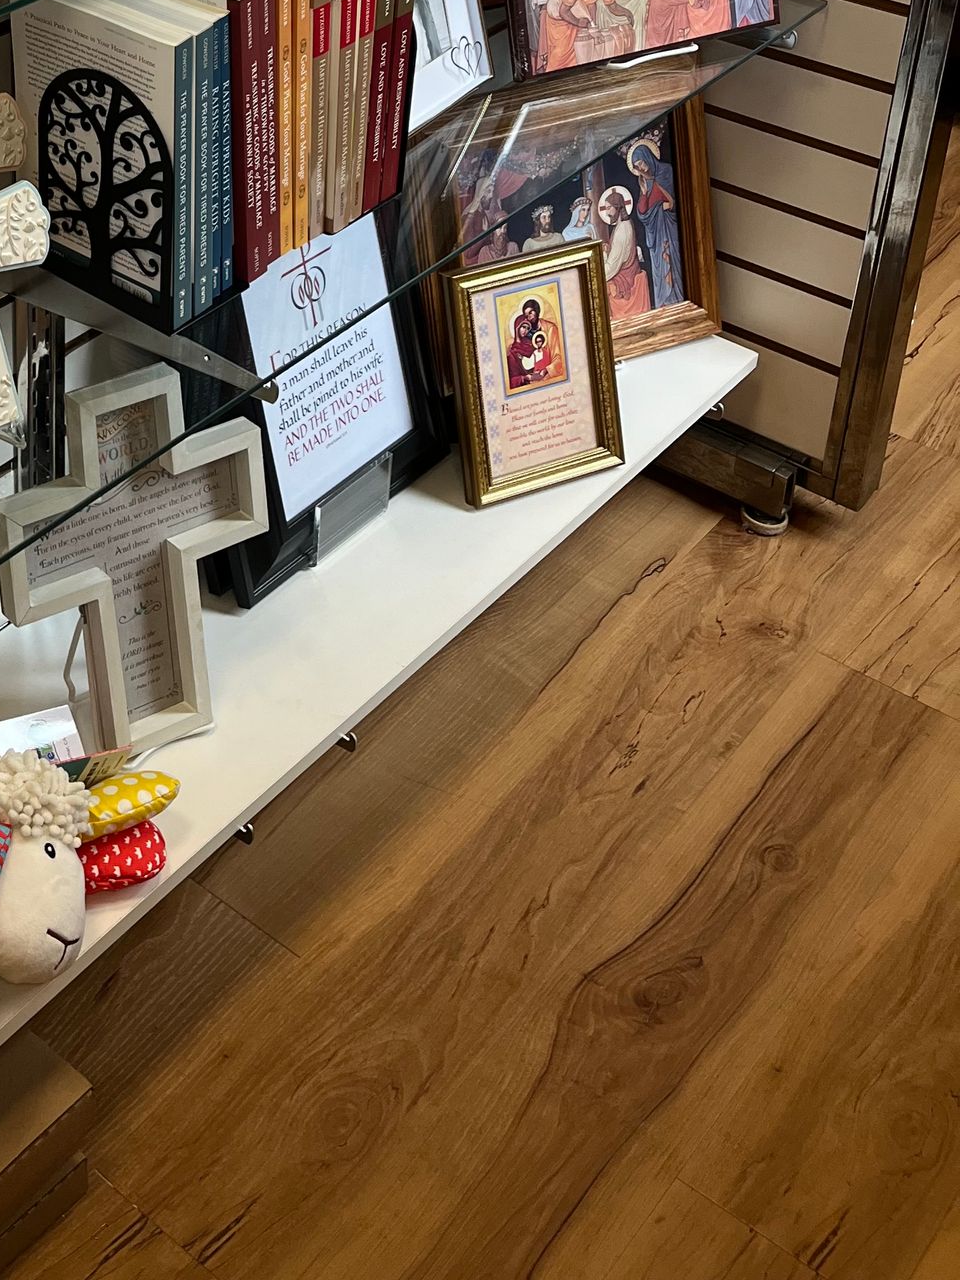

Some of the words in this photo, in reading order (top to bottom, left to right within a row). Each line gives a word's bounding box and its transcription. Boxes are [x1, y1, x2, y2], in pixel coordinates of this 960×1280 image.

[400, 29, 408, 55] LOVE
[397, 58, 406, 78] AND
[222, 80, 230, 133] RAISING
[391, 80, 404, 150] RESPONSIBILITY
[179, 113, 187, 153] PRAYER
[179, 155, 187, 183] BOOK
[222, 136, 230, 192] UPRIGHT
[179, 185, 187, 205] FOR
[222, 196, 230, 225] KIDS
[178, 207, 186, 235] TIRED
[178, 237, 186, 281] PARENTS
[279, 390, 307, 415] father
[307, 372, 325, 393] and
[325, 353, 357, 382] mother
[357, 339, 375, 360] and
[289, 368, 310, 388] man
[310, 352, 332, 373] shall
[333, 337, 354, 358] leave
[355, 327, 368, 342] his
[278, 413, 300, 434] shall
[300, 401, 312, 417] be
[311, 383, 340, 411] joined
[340, 377, 350, 390] to
[350, 365, 364, 383] his
[284, 423, 309, 449] AND
[308, 408, 330, 430] THE
[330, 390, 355, 414] TWO
[355, 370, 385, 399] SHALL
[97, 405, 142, 440] WELCOME
[287, 447, 303, 467] BE
[302, 423, 334, 454] MADE
[333, 405, 361, 432] INTO
[360, 388, 387, 414] ONE.
